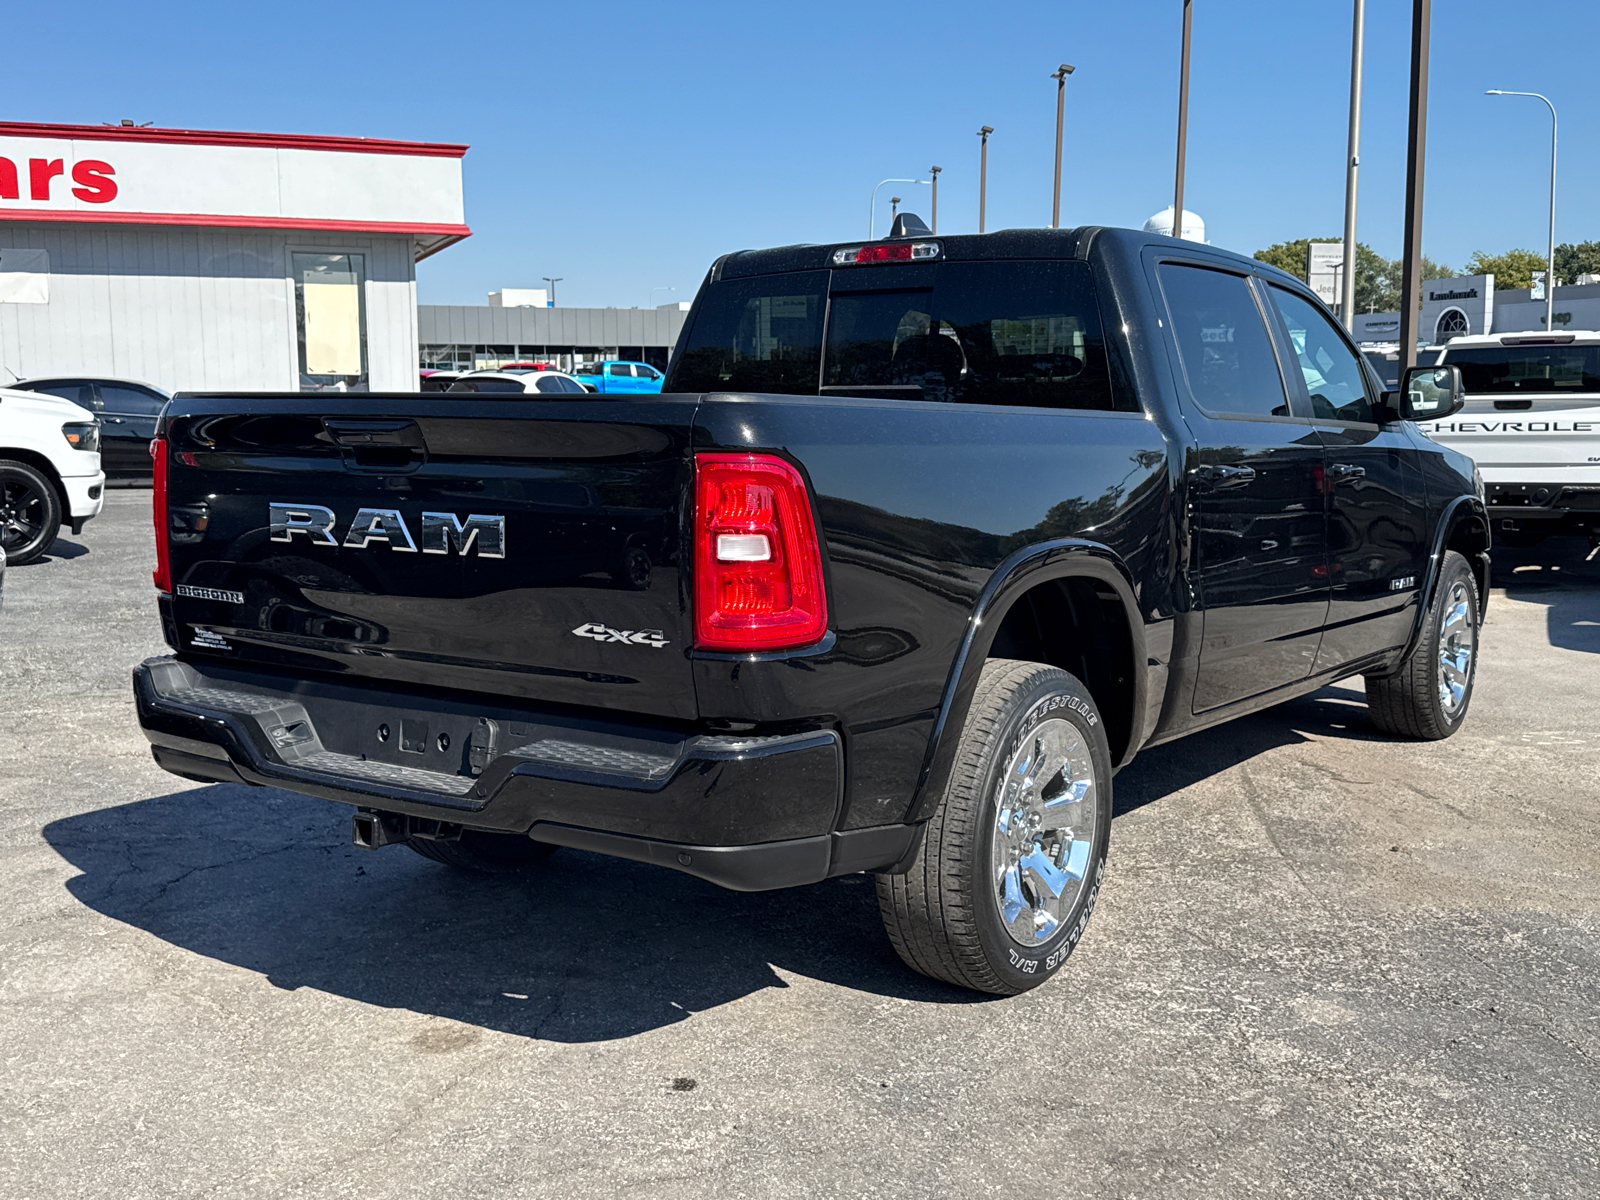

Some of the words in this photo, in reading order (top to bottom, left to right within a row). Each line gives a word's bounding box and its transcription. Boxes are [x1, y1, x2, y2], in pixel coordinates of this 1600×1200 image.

[1429, 288, 1479, 301] Landmark
[269, 502, 506, 559] RAM
[1389, 576, 1415, 591] RAM
[571, 622, 670, 648] 4x4
